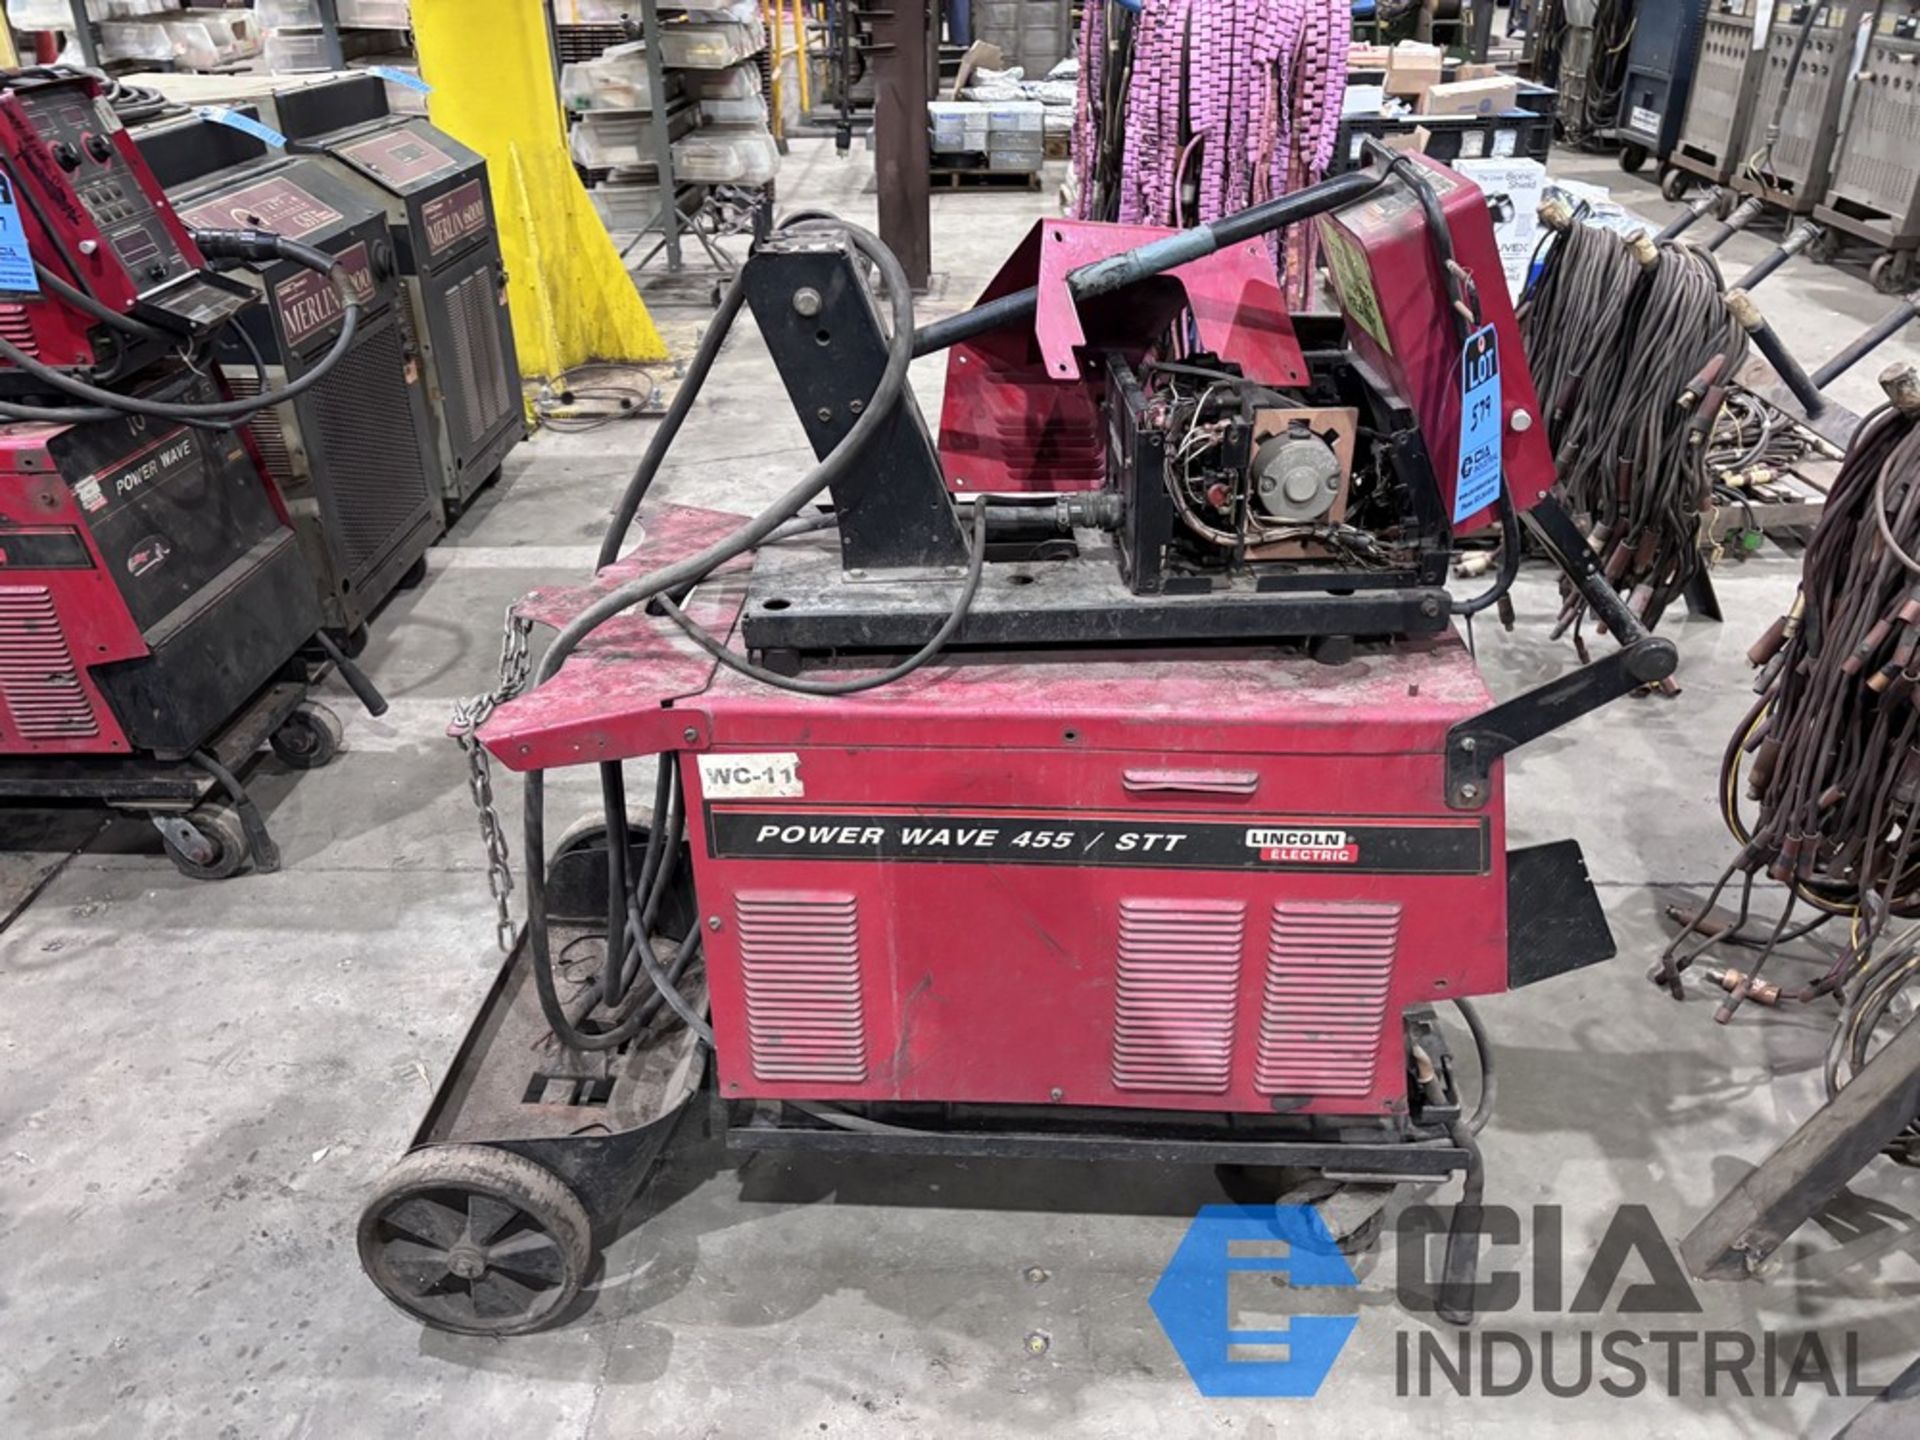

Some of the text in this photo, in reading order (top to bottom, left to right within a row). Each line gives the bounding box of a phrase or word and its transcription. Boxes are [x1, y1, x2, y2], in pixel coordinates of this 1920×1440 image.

[1508, 180, 1536, 190] Shield
[427, 211, 465, 247] MERLIN
[284, 285, 341, 335] MERLIN
[1469, 349, 1494, 389] LOT
[115, 460, 159, 496] POWER
[159, 439, 191, 468] WAVE
[755, 824, 1188, 855] POWER WAVE 455 / STT
[1251, 832, 1340, 846] LINCOLN
[1270, 849, 1350, 860] ELECTRIC
